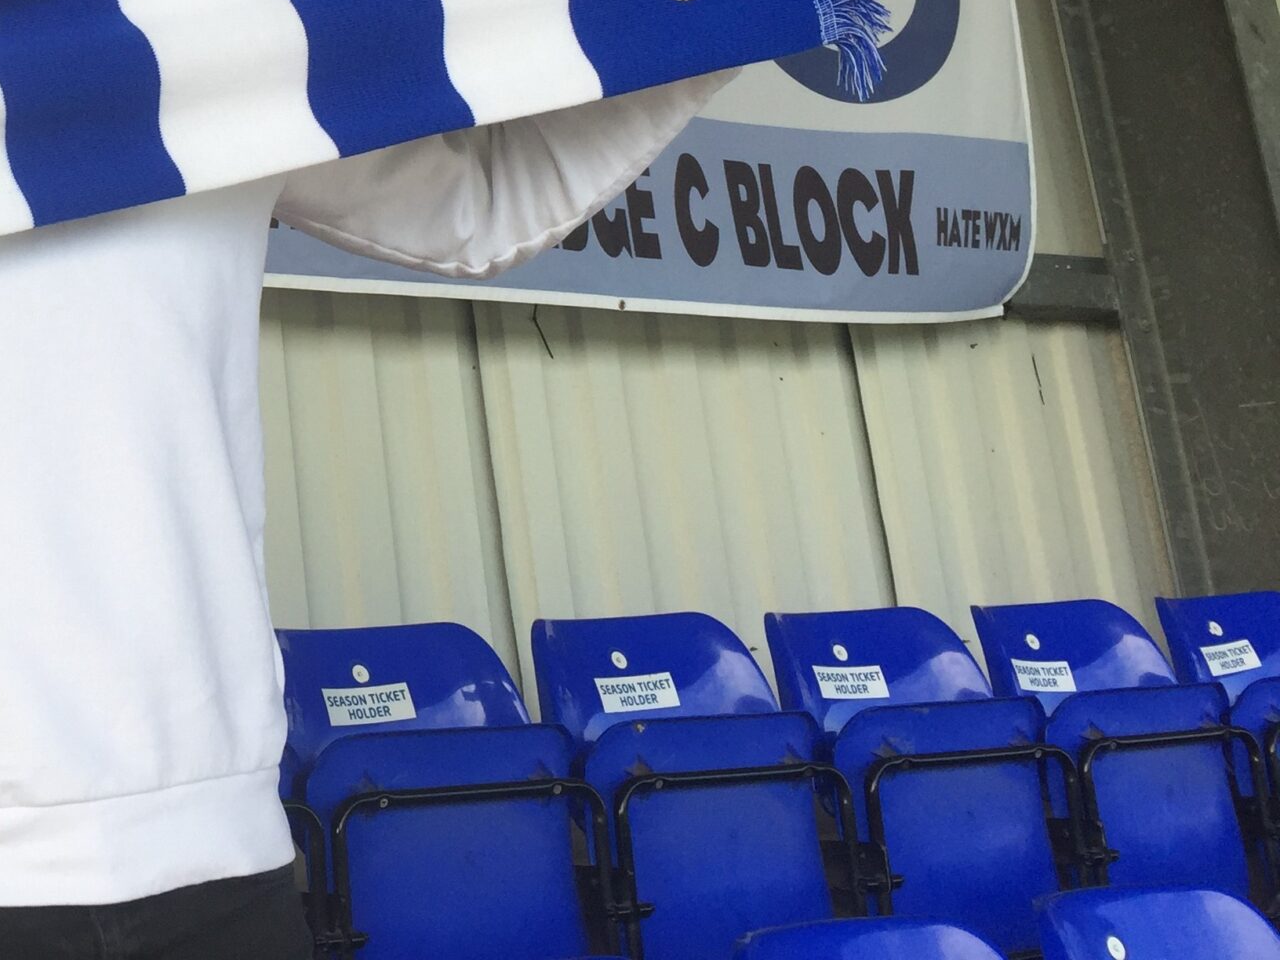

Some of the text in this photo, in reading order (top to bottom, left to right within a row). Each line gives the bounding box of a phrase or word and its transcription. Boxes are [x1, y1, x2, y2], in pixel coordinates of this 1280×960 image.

[674, 153, 719, 267] C
[723, 159, 919, 277] BLOCK
[936, 207, 1021, 251] HATE WXM
[817, 671, 881, 682] SEASON TICKET
[600, 678, 671, 695] SEASON TICKET
[834, 684, 869, 694] HOLDER
[327, 689, 406, 707] SEASON TICKET
[620, 694, 658, 707] HOLDER
[348, 706, 391, 720] HOLDER
